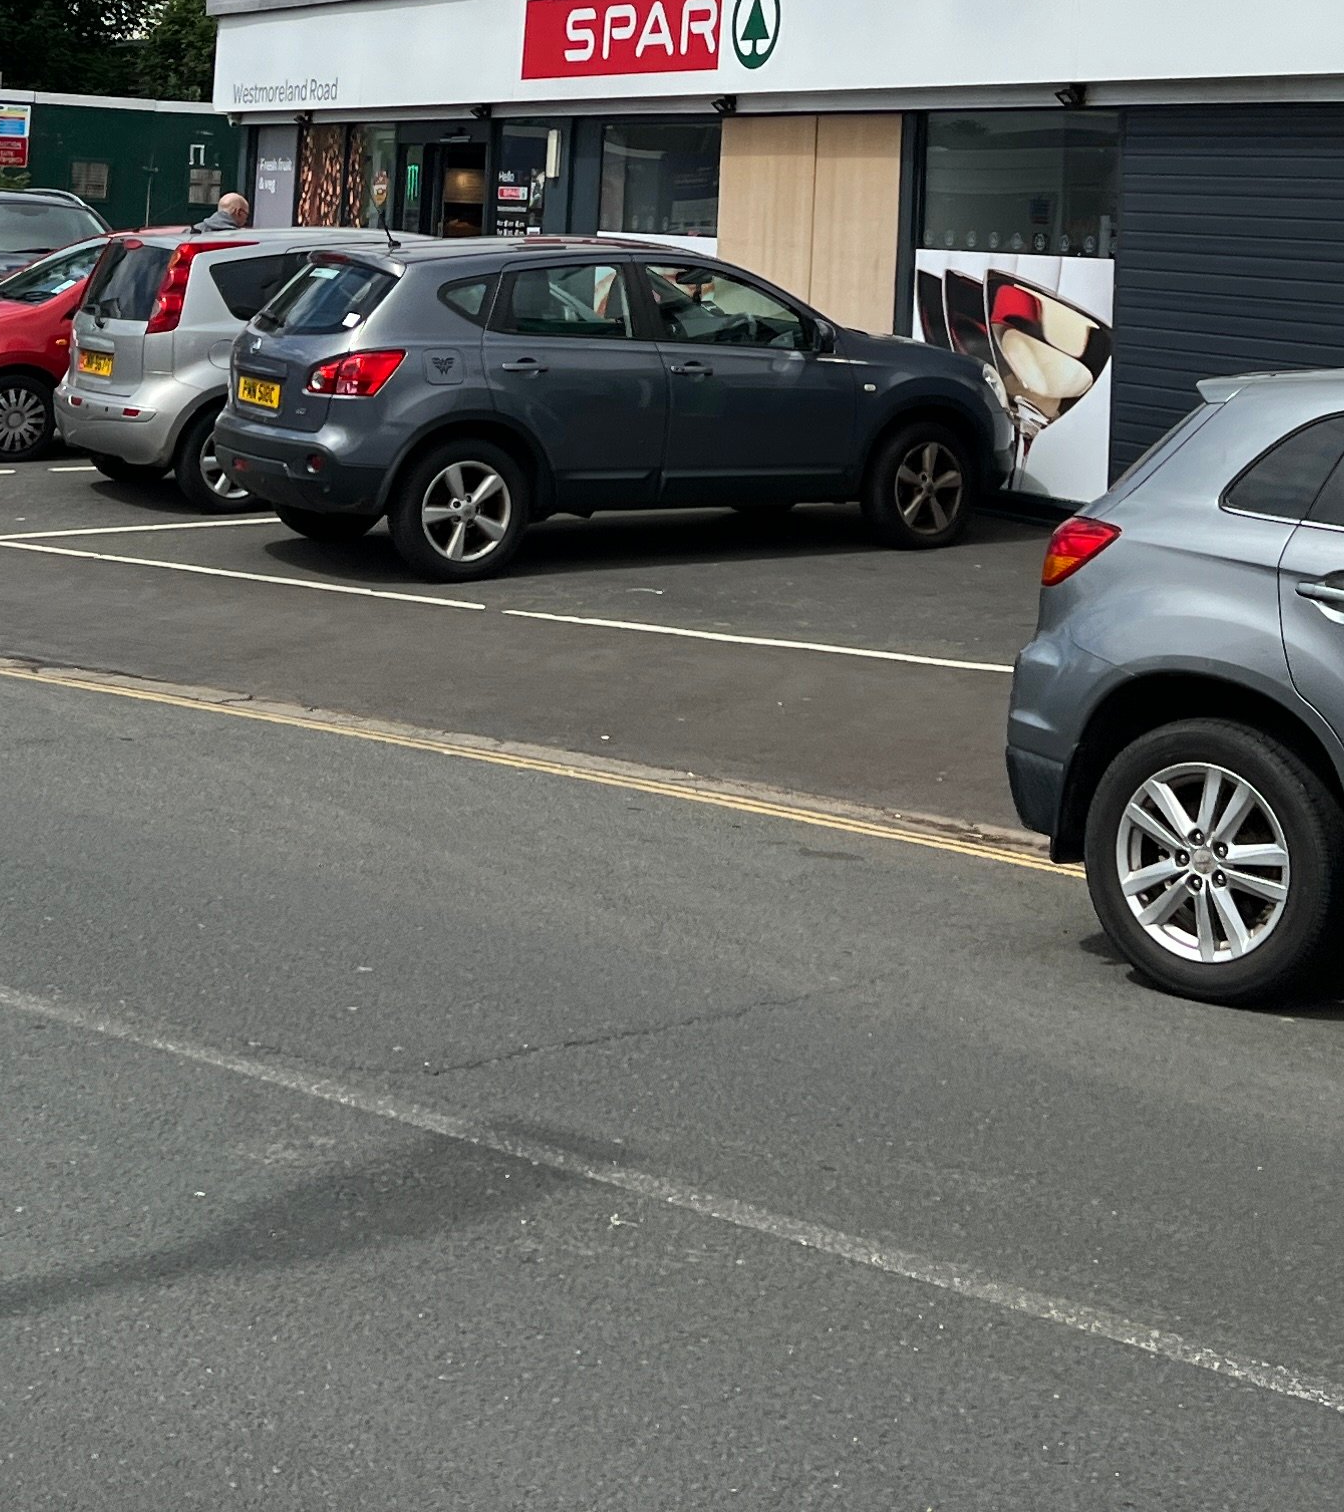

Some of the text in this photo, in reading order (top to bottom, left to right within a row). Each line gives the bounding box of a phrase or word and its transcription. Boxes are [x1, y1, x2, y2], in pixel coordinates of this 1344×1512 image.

[233, 77, 338, 104] Westmoreland Road
[260, 157, 293, 172] Fresh fruit
